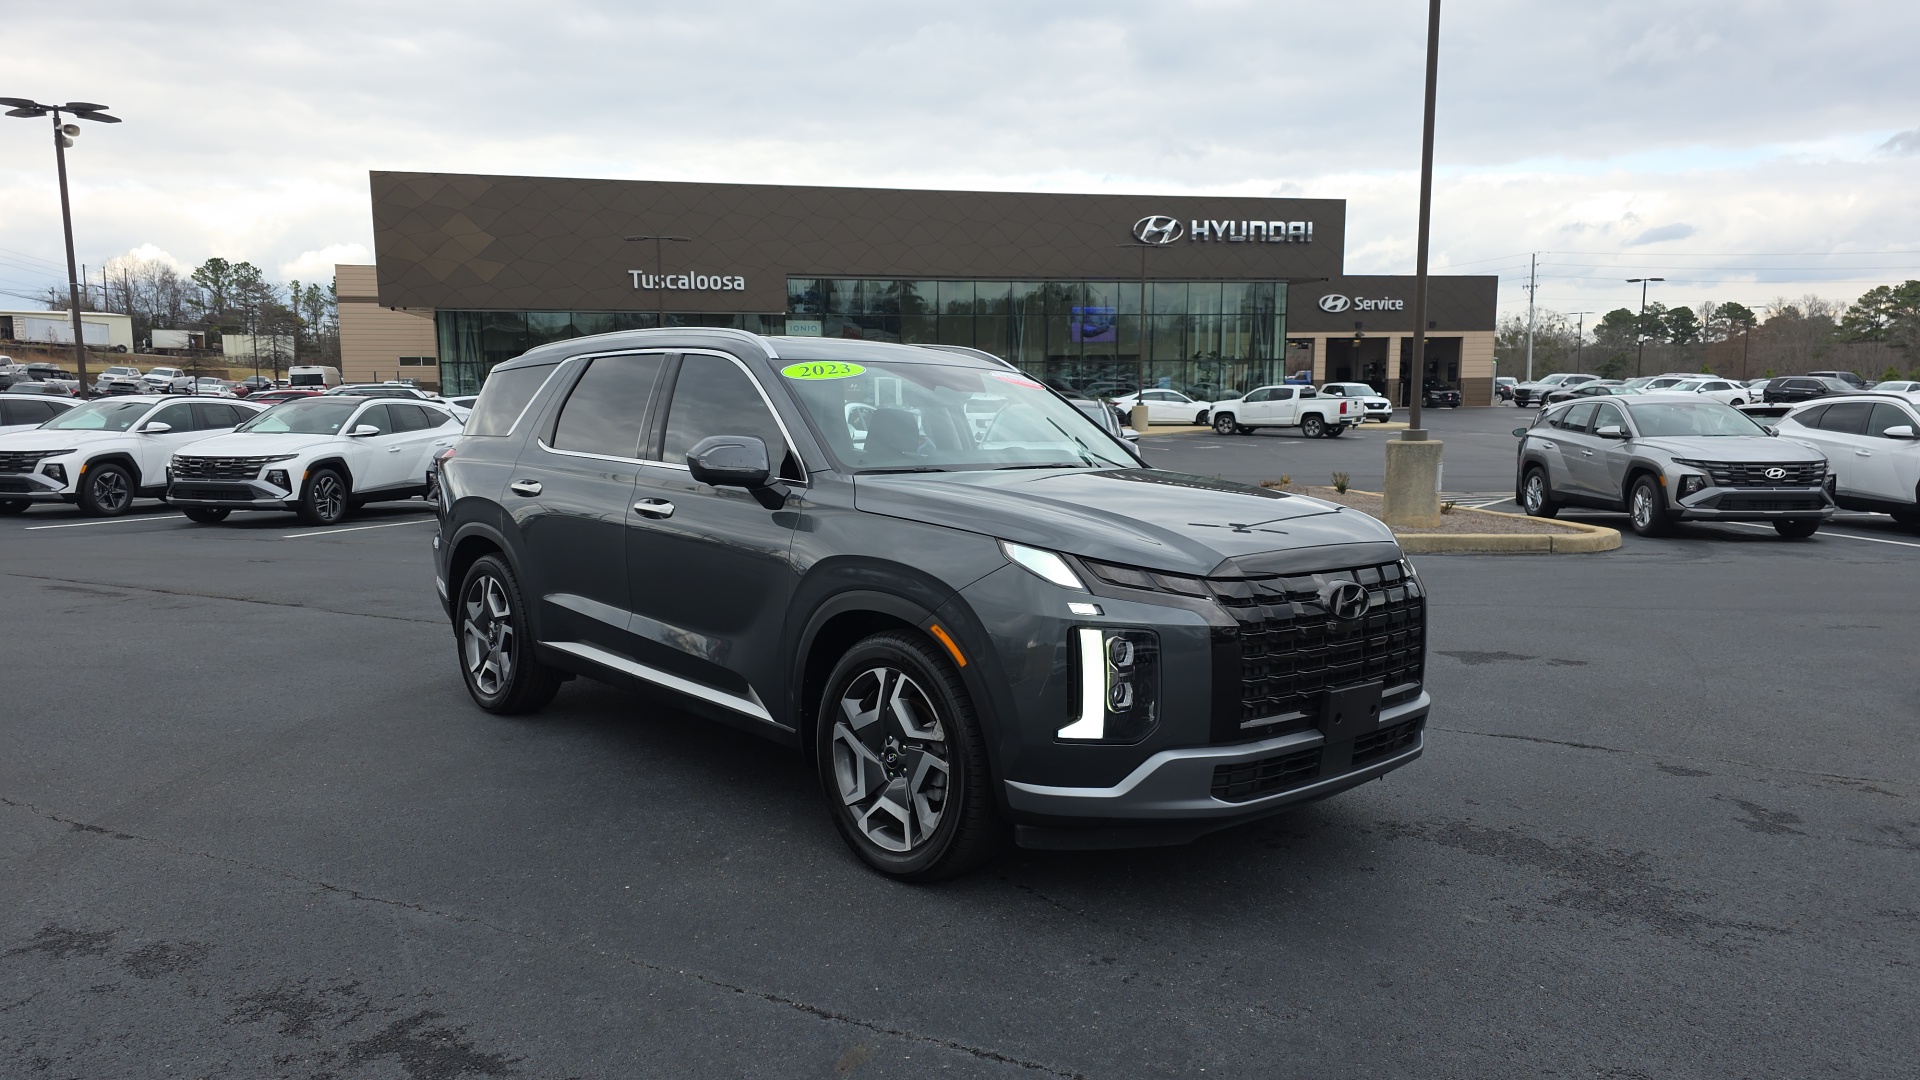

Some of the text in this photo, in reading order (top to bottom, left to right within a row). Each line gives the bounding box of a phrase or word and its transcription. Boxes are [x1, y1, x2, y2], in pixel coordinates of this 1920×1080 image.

[1191, 219, 1313, 242] HYUNDAI
[628, 269, 745, 290] Tuscaloosa
[1353, 296, 1404, 311] Service
[798, 363, 851, 377] 2023
